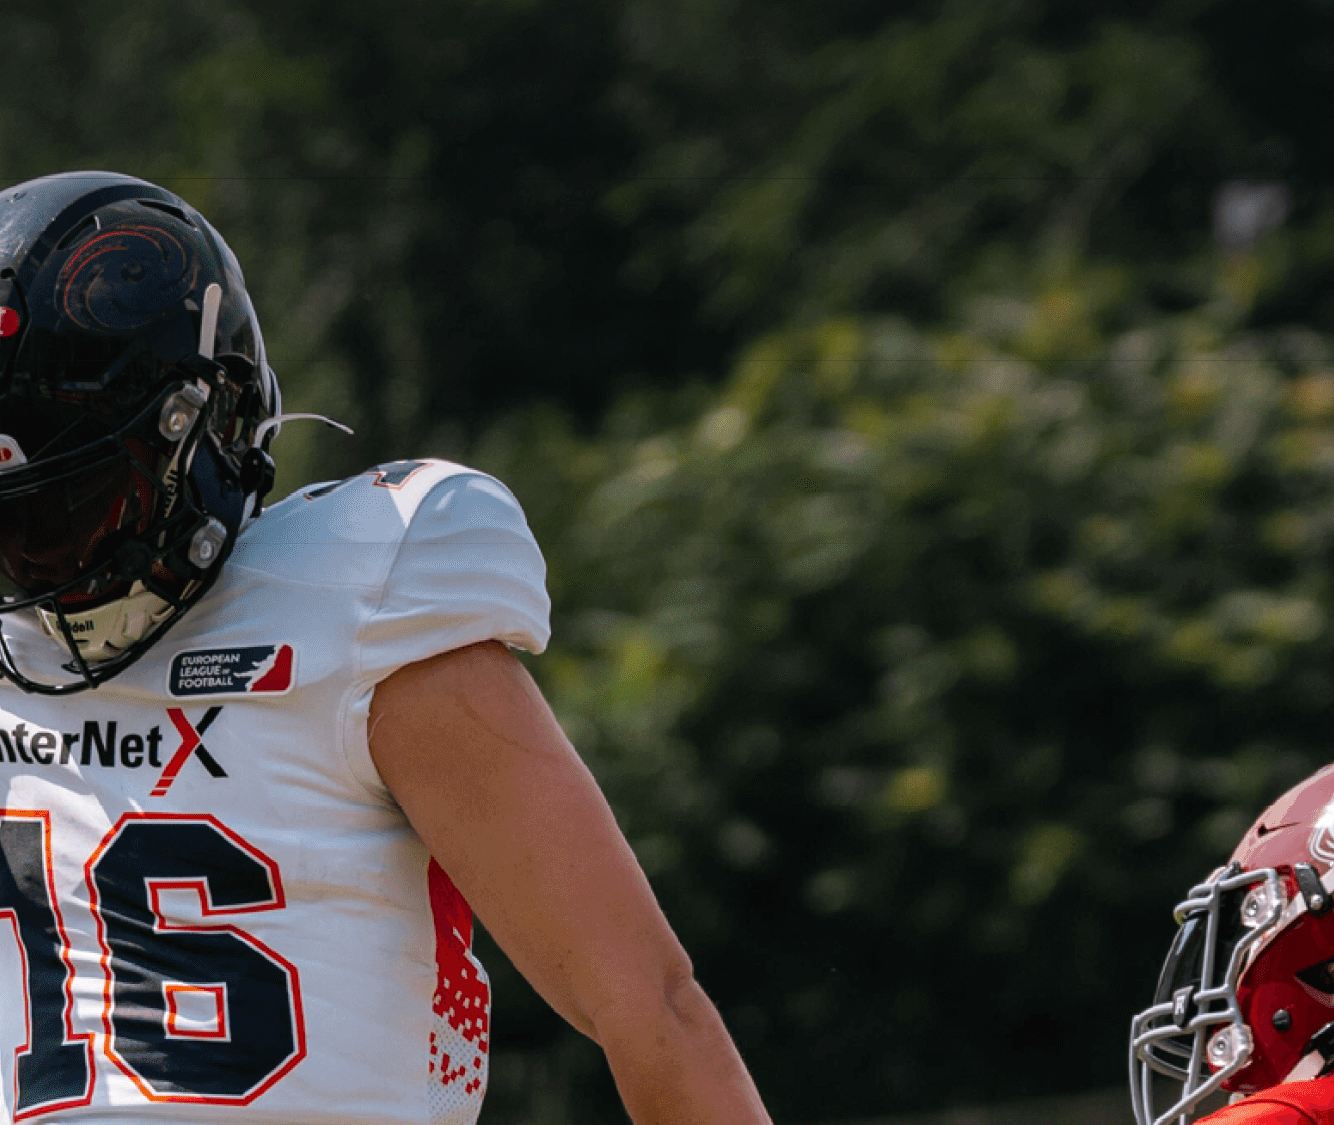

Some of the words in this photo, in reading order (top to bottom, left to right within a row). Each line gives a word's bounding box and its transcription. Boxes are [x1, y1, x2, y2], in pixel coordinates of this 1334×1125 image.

[182, 653, 241, 667] EUROPEAN
[180, 665, 222, 677] LEAGUE
[178, 675, 234, 689] FOOTBALL
